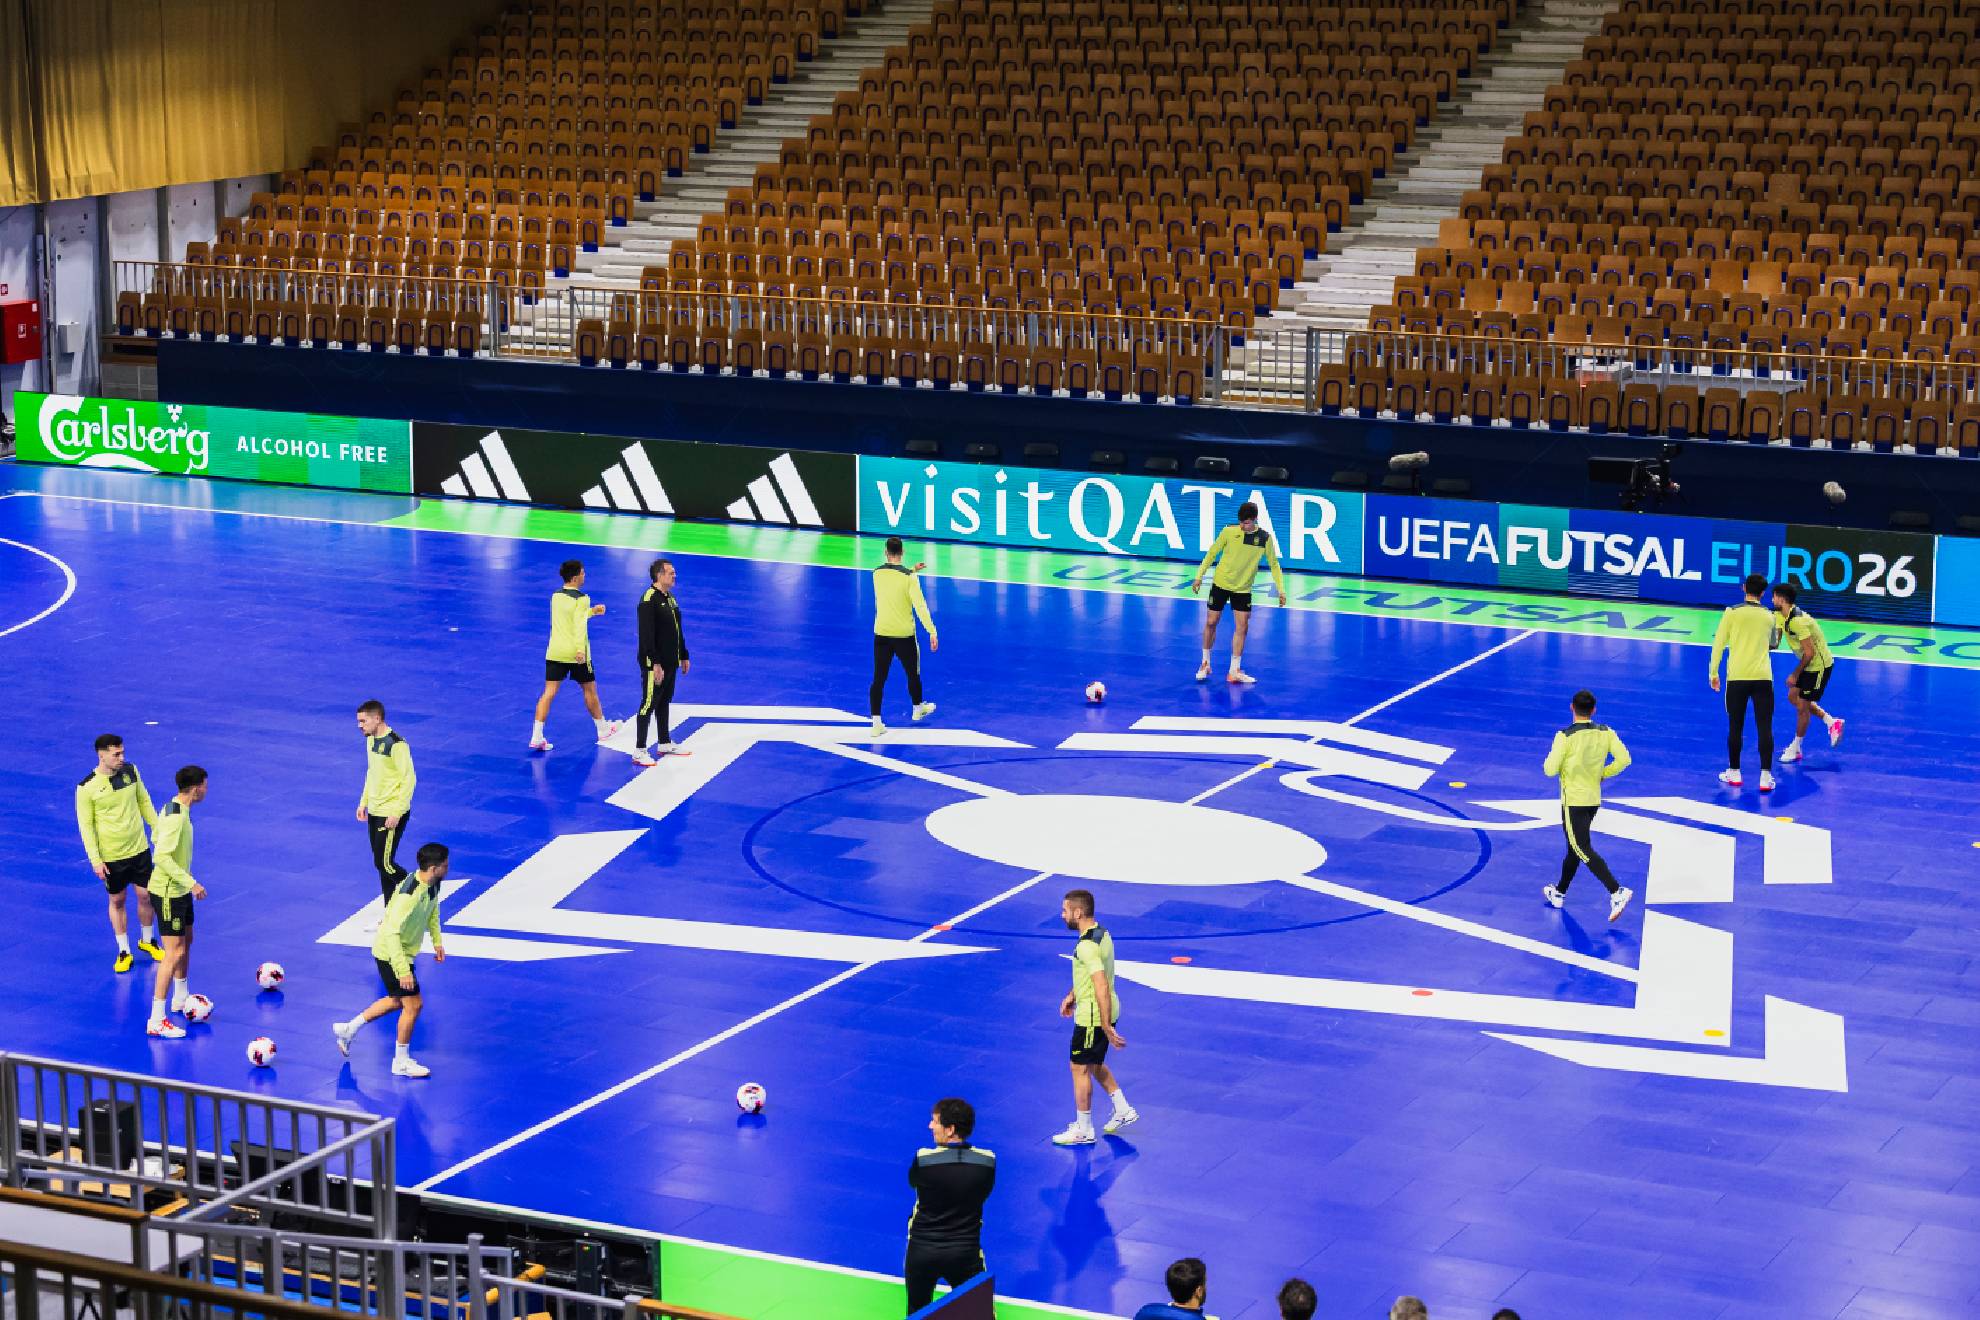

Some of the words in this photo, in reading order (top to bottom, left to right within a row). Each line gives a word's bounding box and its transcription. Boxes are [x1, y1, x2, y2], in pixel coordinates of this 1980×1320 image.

[39, 394, 211, 475] Carlsberg
[237, 436, 331, 459] ALCOHOL
[339, 443, 388, 463] FREE
[1380, 516, 1499, 563] UEFA
[1507, 525, 1701, 580] FUTSAL
[1297, 587, 1692, 635] FUTSAL
